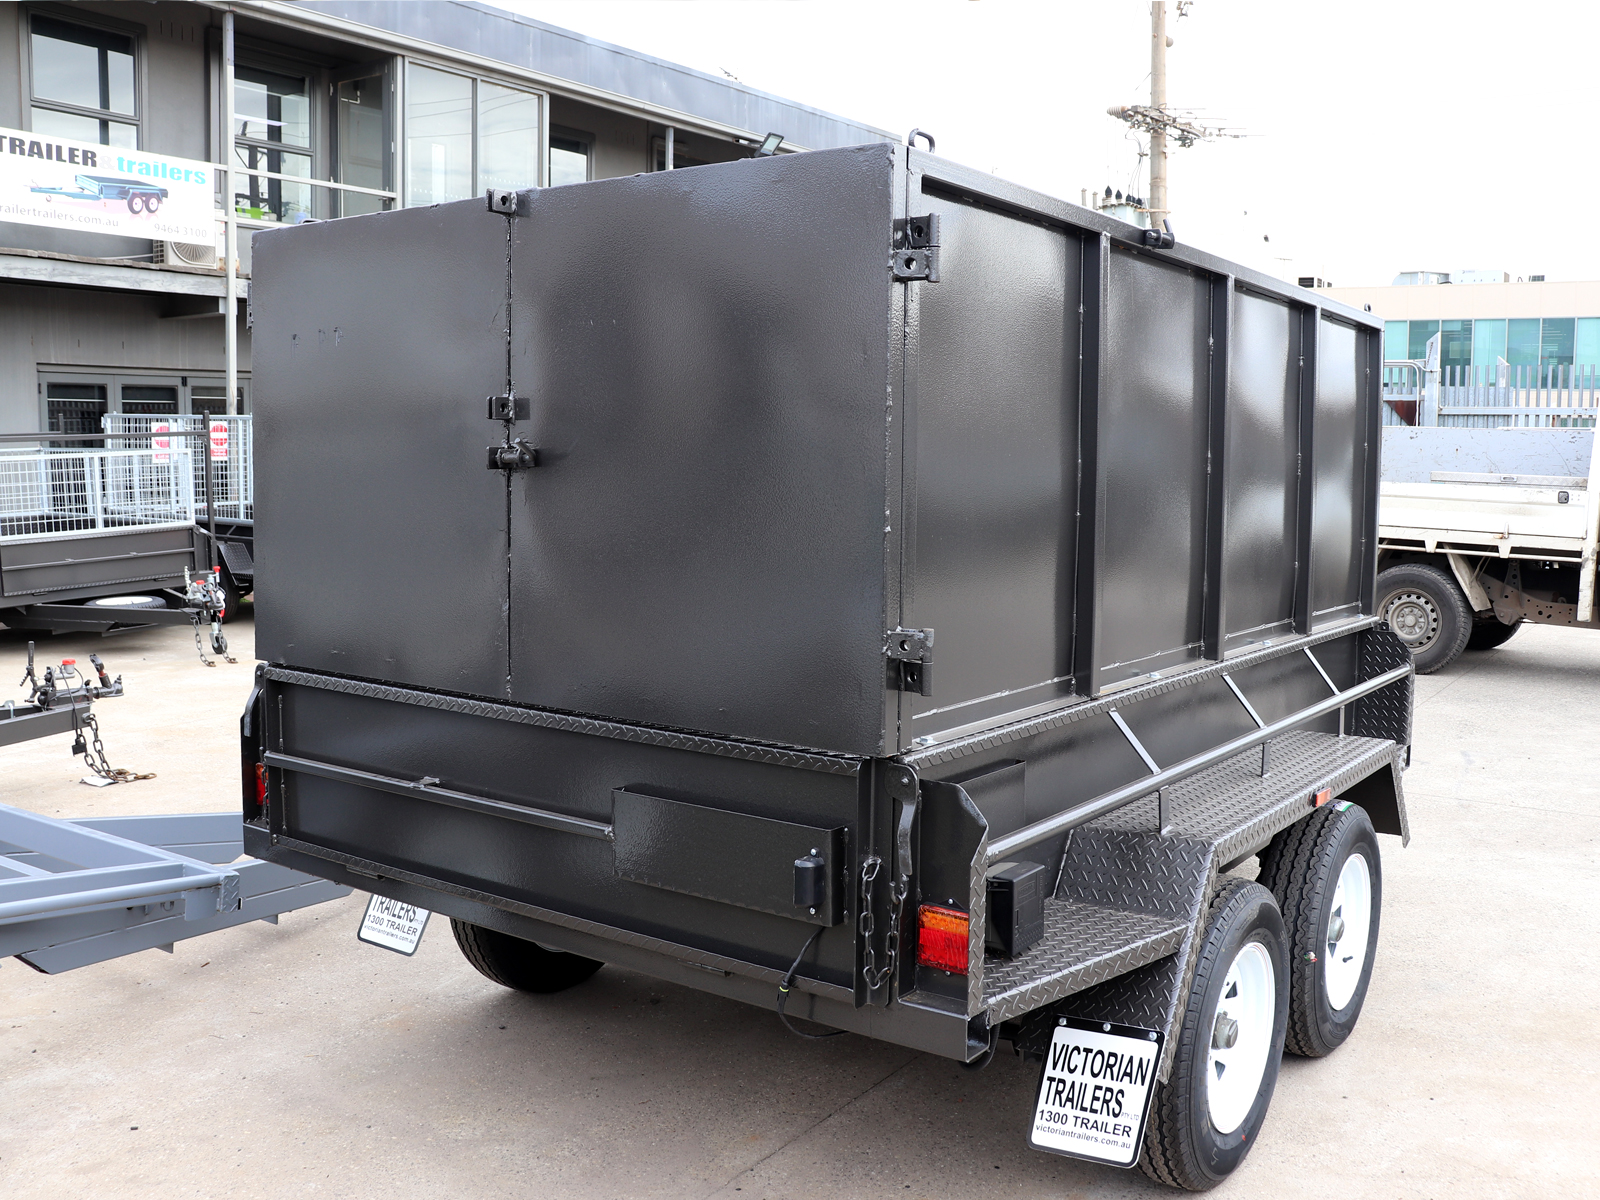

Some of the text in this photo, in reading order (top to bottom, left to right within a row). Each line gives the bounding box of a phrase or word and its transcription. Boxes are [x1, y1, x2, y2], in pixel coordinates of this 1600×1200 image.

[117, 156, 206, 185] trailers
[154, 222, 207, 238] 9464 3100
[367, 914, 385, 926] 1300
[386, 919, 418, 937] TRAILER
[1051, 1042, 1151, 1087] VICTORIAN
[1045, 1076, 1125, 1118] TRAILERS
[1035, 1124, 1131, 1149] victoriantrailers.com.au
[1039, 1109, 1132, 1138] 1300 TRAILER
